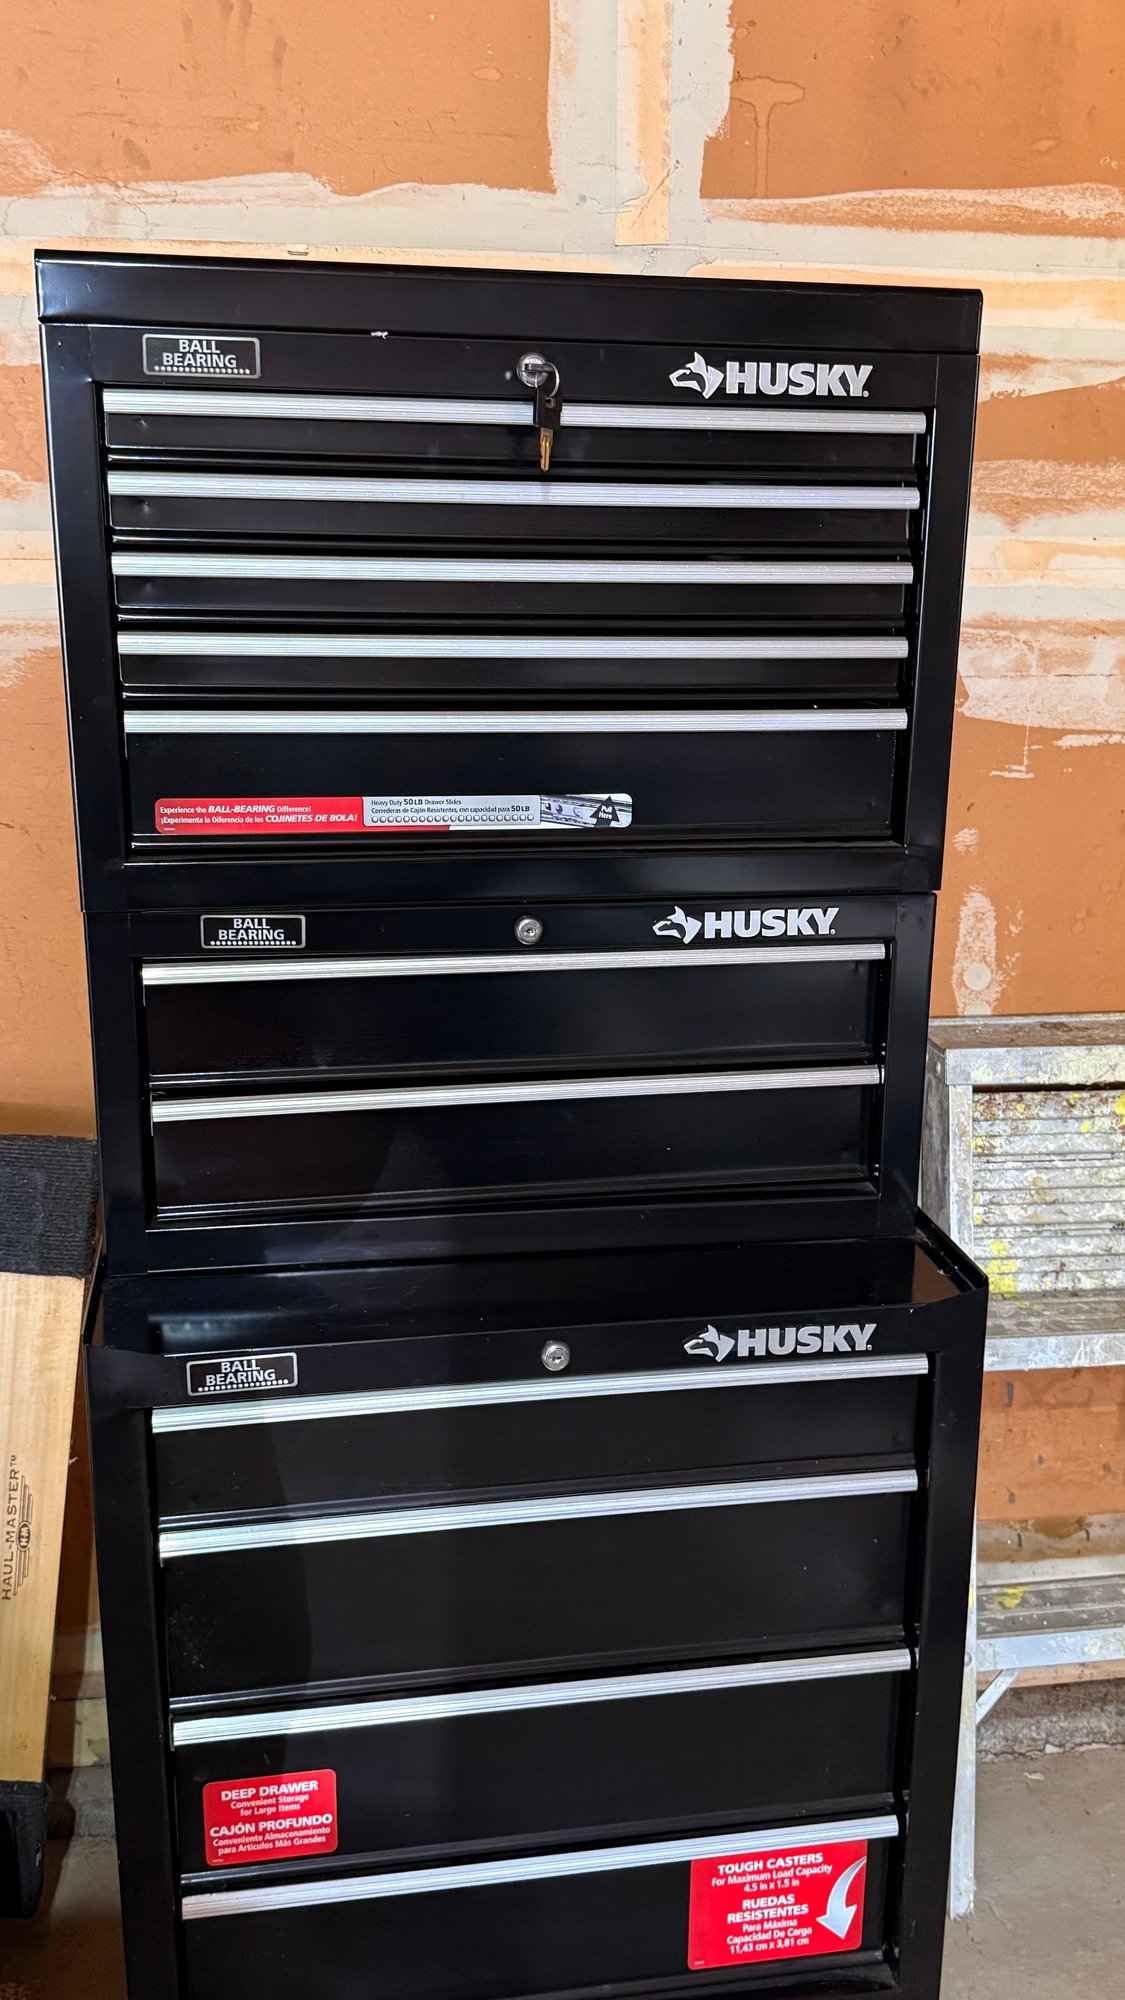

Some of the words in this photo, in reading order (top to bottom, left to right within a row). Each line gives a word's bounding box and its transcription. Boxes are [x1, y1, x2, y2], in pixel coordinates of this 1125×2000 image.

[178, 339, 221, 353] BALL
[162, 352, 237, 368] BEARING
[725, 360, 874, 398] HUSKY
[160, 806, 195, 814] Experience
[208, 805, 275, 814] BALL-BEARING
[277, 805, 312, 813] Difference!
[371, 799, 387, 807] Heavy
[389, 799, 403, 807] Duty
[371, 806, 401, 814] Correderas
[411, 806, 426, 814] Cajón
[427, 805, 458, 814] Resistentes,
[470, 805, 497, 814] capacidad
[498, 806, 510, 814] para
[160, 817, 203, 825] ¡Experimenta
[265, 814, 313, 823] COJINETES
[315, 814, 327, 822] DE
[329, 814, 358, 822] BOLA!
[233, 918, 271, 929] BALL
[704, 907, 840, 939] HUSKY
[218, 929, 285, 940] BEARING
[737, 1323, 877, 1357] HUSKY
[221, 1359, 260, 1373] BALL
[205, 1369, 276, 1386] BEARING
[221, 1788, 256, 1802] DEEP
[259, 1780, 319, 1796] DRAWER
[230, 1797, 276, 1809] Convenient
[278, 1793, 309, 1803] Storage
[240, 1808, 252, 1816] for
[254, 1806, 276, 1815] Large
[278, 1803, 300, 1812] Items
[209, 1822, 255, 1837] CAJÓN
[259, 1813, 333, 1831] PROFUNDO
[212, 1835, 263, 1847] Conveniente
[264, 1826, 331, 1840] Almacenamiento
[218, 1846, 236, 1856] para
[275, 1839, 292, 1848] Más
[293, 1836, 326, 1845] Grandes
[718, 1861, 763, 1875] TOUGH
[766, 1852, 823, 1869] CASTERS
[711, 1877, 726, 1887] For
[727, 1872, 771, 1884] Maximum
[772, 1869, 794, 1879] Load
[795, 1864, 833, 1876] Capacity
[744, 1883, 758, 1893] 4.5
[759, 1882, 768, 1890] in
[777, 1880, 790, 1889] 1.5
[791, 1879, 799, 1887] in
[742, 1893, 795, 1910] RUEDAS
[727, 1904, 809, 1924] RESISTENTES
[742, 1922, 762, 1933] Para
[763, 1918, 798, 1931] Máxima
[726, 1932, 772, 1946] Capacidad
[773, 1929, 786, 1938] De
[787, 1927, 812, 1937] Carga
[729, 1944, 754, 1955] 11,43
[755, 1941, 768, 1951] cm
[776, 1938, 794, 1948] 3,81
[796, 1937, 810, 1946] cm
